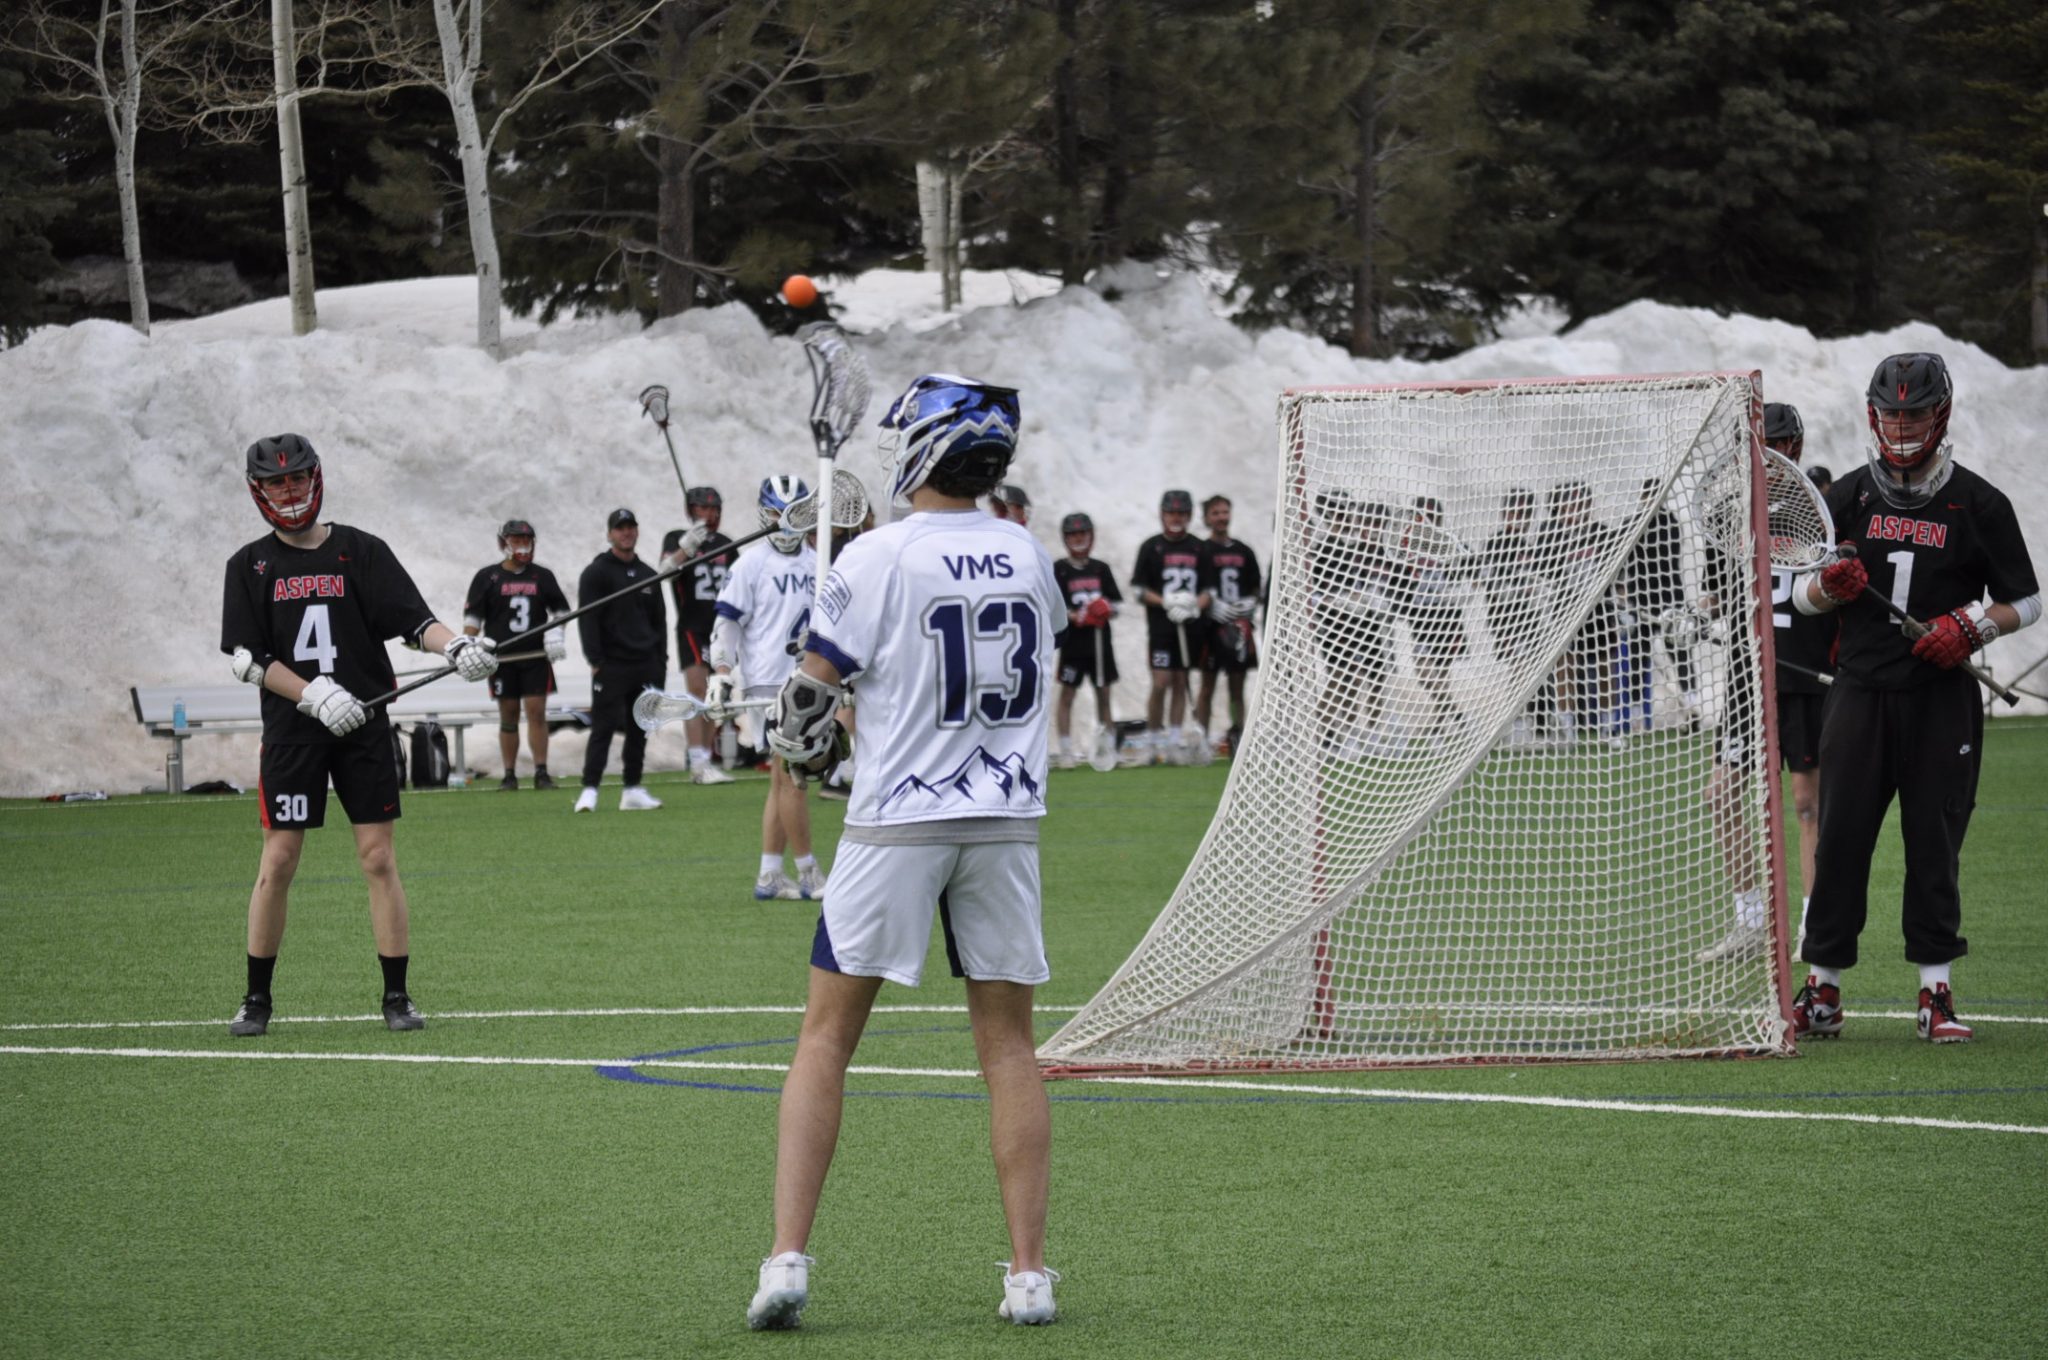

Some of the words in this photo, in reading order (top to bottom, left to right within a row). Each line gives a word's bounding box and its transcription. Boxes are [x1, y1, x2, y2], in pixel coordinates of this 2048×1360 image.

[1866, 514, 1948, 549] ASPEN
[942, 553, 1014, 581] VMS
[274, 574, 345, 601] ASPEN
[1220, 568, 1241, 604] 6
[1886, 551, 1915, 626] 1
[509, 596, 531, 633] 3
[293, 604, 338, 675] 4
[920, 593, 1043, 730] 13
[494, 679, 503, 695] 3
[276, 794, 308, 822] 30
